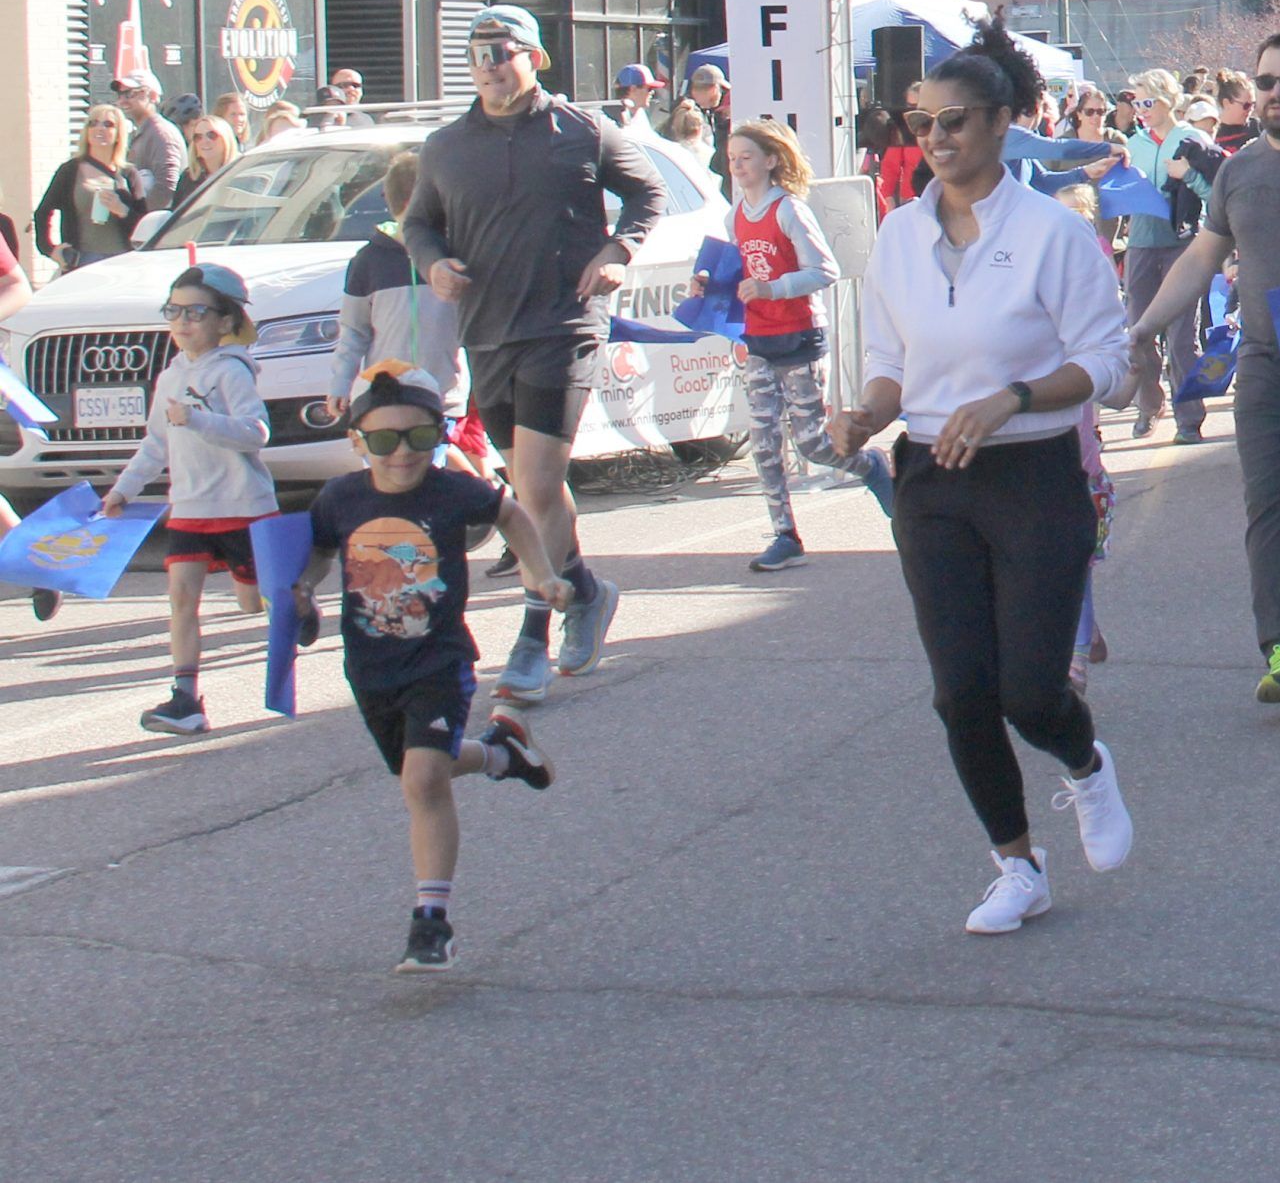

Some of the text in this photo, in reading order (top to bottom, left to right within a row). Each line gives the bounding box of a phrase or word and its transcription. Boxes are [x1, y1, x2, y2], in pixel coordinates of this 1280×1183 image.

[222, 29, 297, 58] EVOLUTION
[993, 251, 1013, 263] CK
[616, 283, 688, 318] FINIS
[671, 352, 730, 372] Running
[78, 395, 144, 418] CSSV 550
[602, 402, 736, 429] www.runninggoattiming.com
